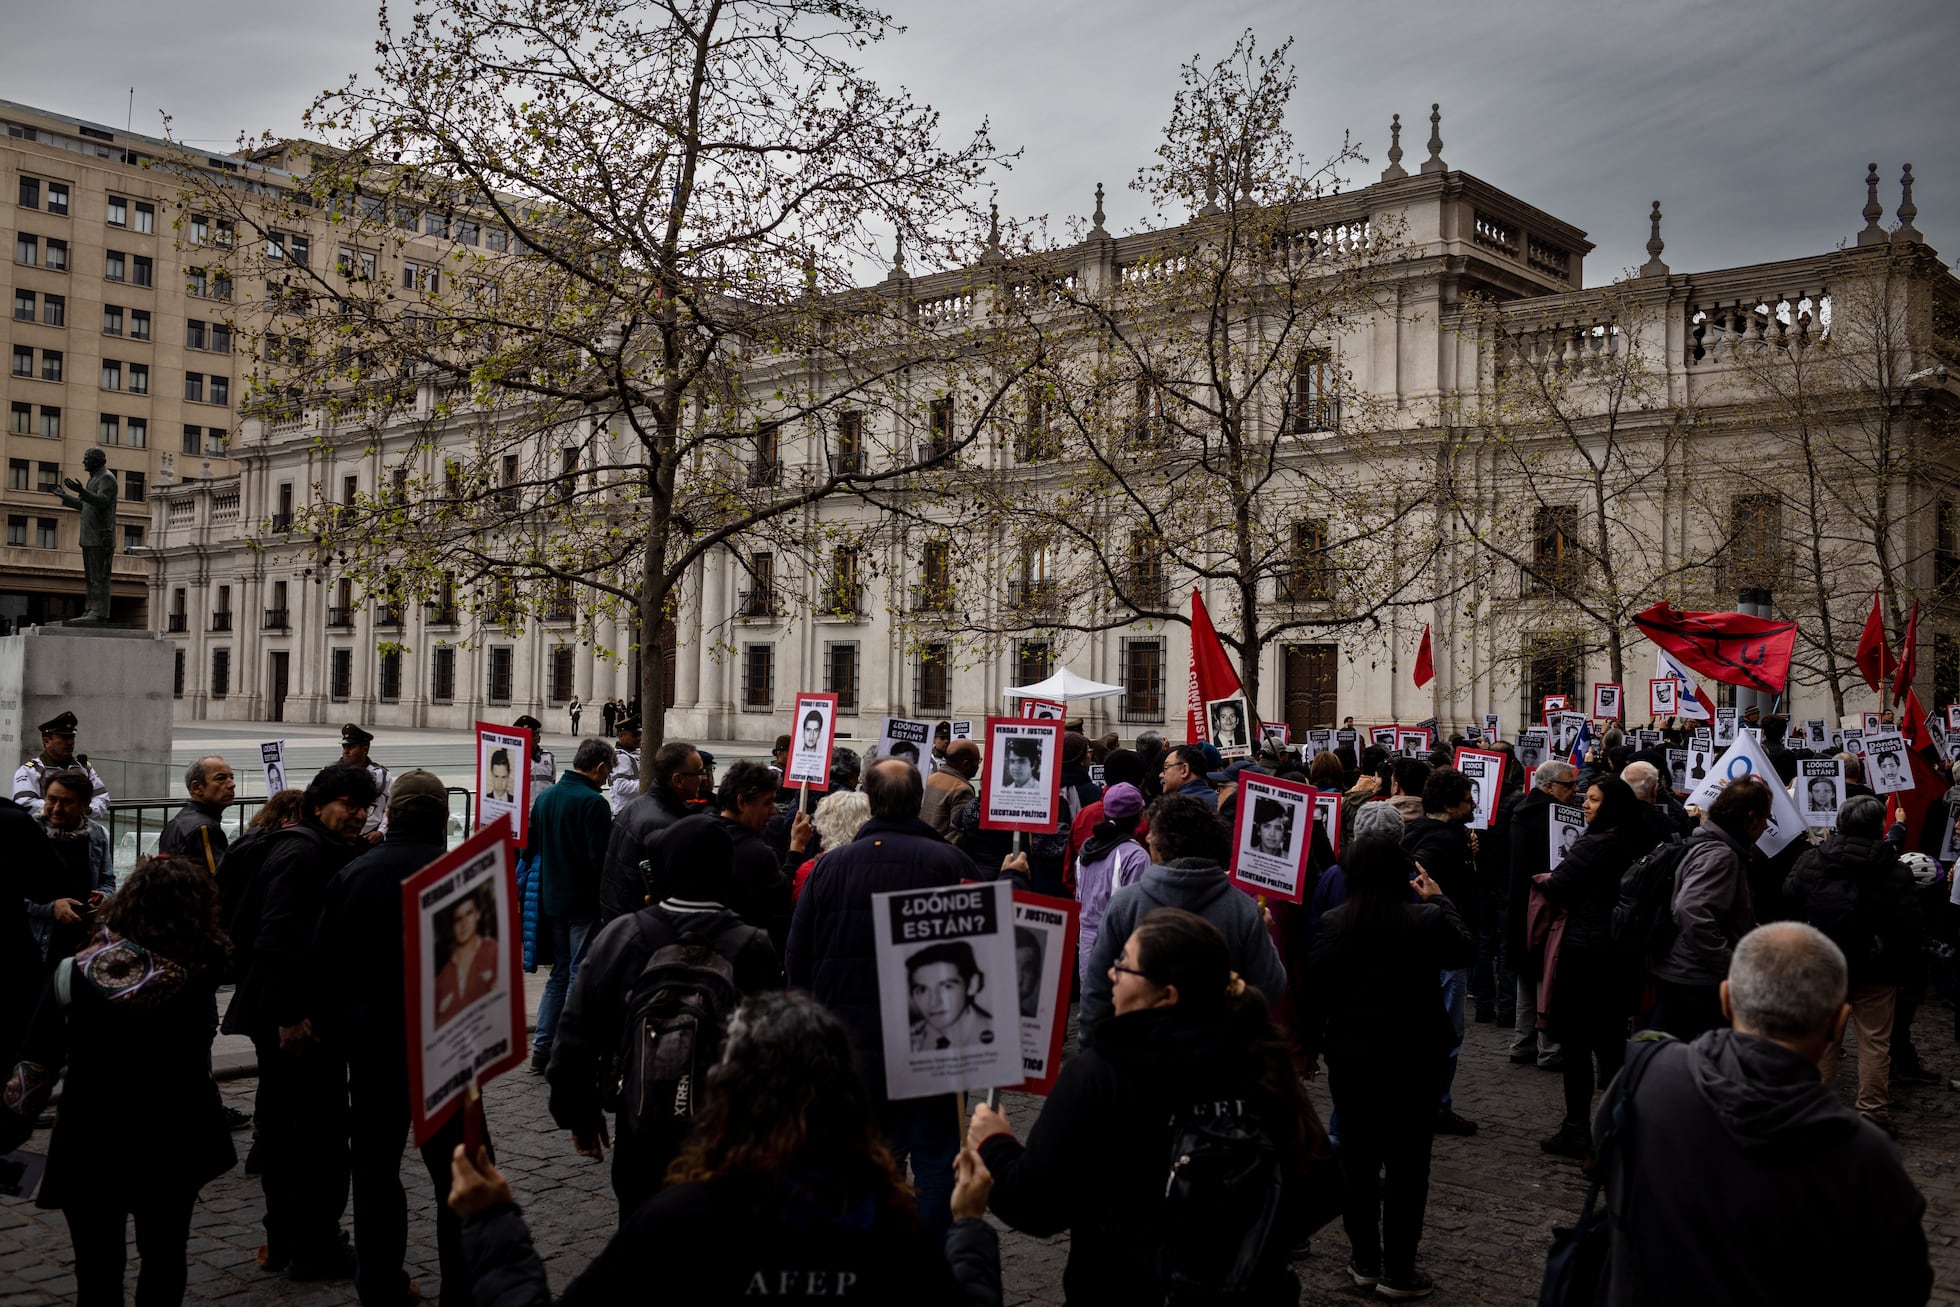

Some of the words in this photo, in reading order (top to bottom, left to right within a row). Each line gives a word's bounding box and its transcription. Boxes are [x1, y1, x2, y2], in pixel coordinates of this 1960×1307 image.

[1190, 671, 1207, 742] COMUNIST
[891, 730, 924, 741] ESTÁN?
[996, 726, 1018, 734] VERDAD
[1806, 760, 1835, 769] ¿DÓNDE
[1807, 767, 1836, 776] ESTÁN?
[1248, 783, 1270, 794] VERDAD
[1277, 790, 1303, 802] JUSTICIA
[990, 808, 1020, 817] EJECUTADO
[1021, 809, 1047, 818] POLÍTICO
[1237, 869, 1266, 884] EJECUTADO
[1267, 876, 1293, 891] POLÍTICO
[901, 890, 983, 917] ¿DÓNDE
[1016, 906, 1021, 919] Y
[1024, 908, 1063, 925] JUSTICIA
[903, 914, 986, 939] ESTÁN?
[744, 1270, 858, 1296] AFEP
